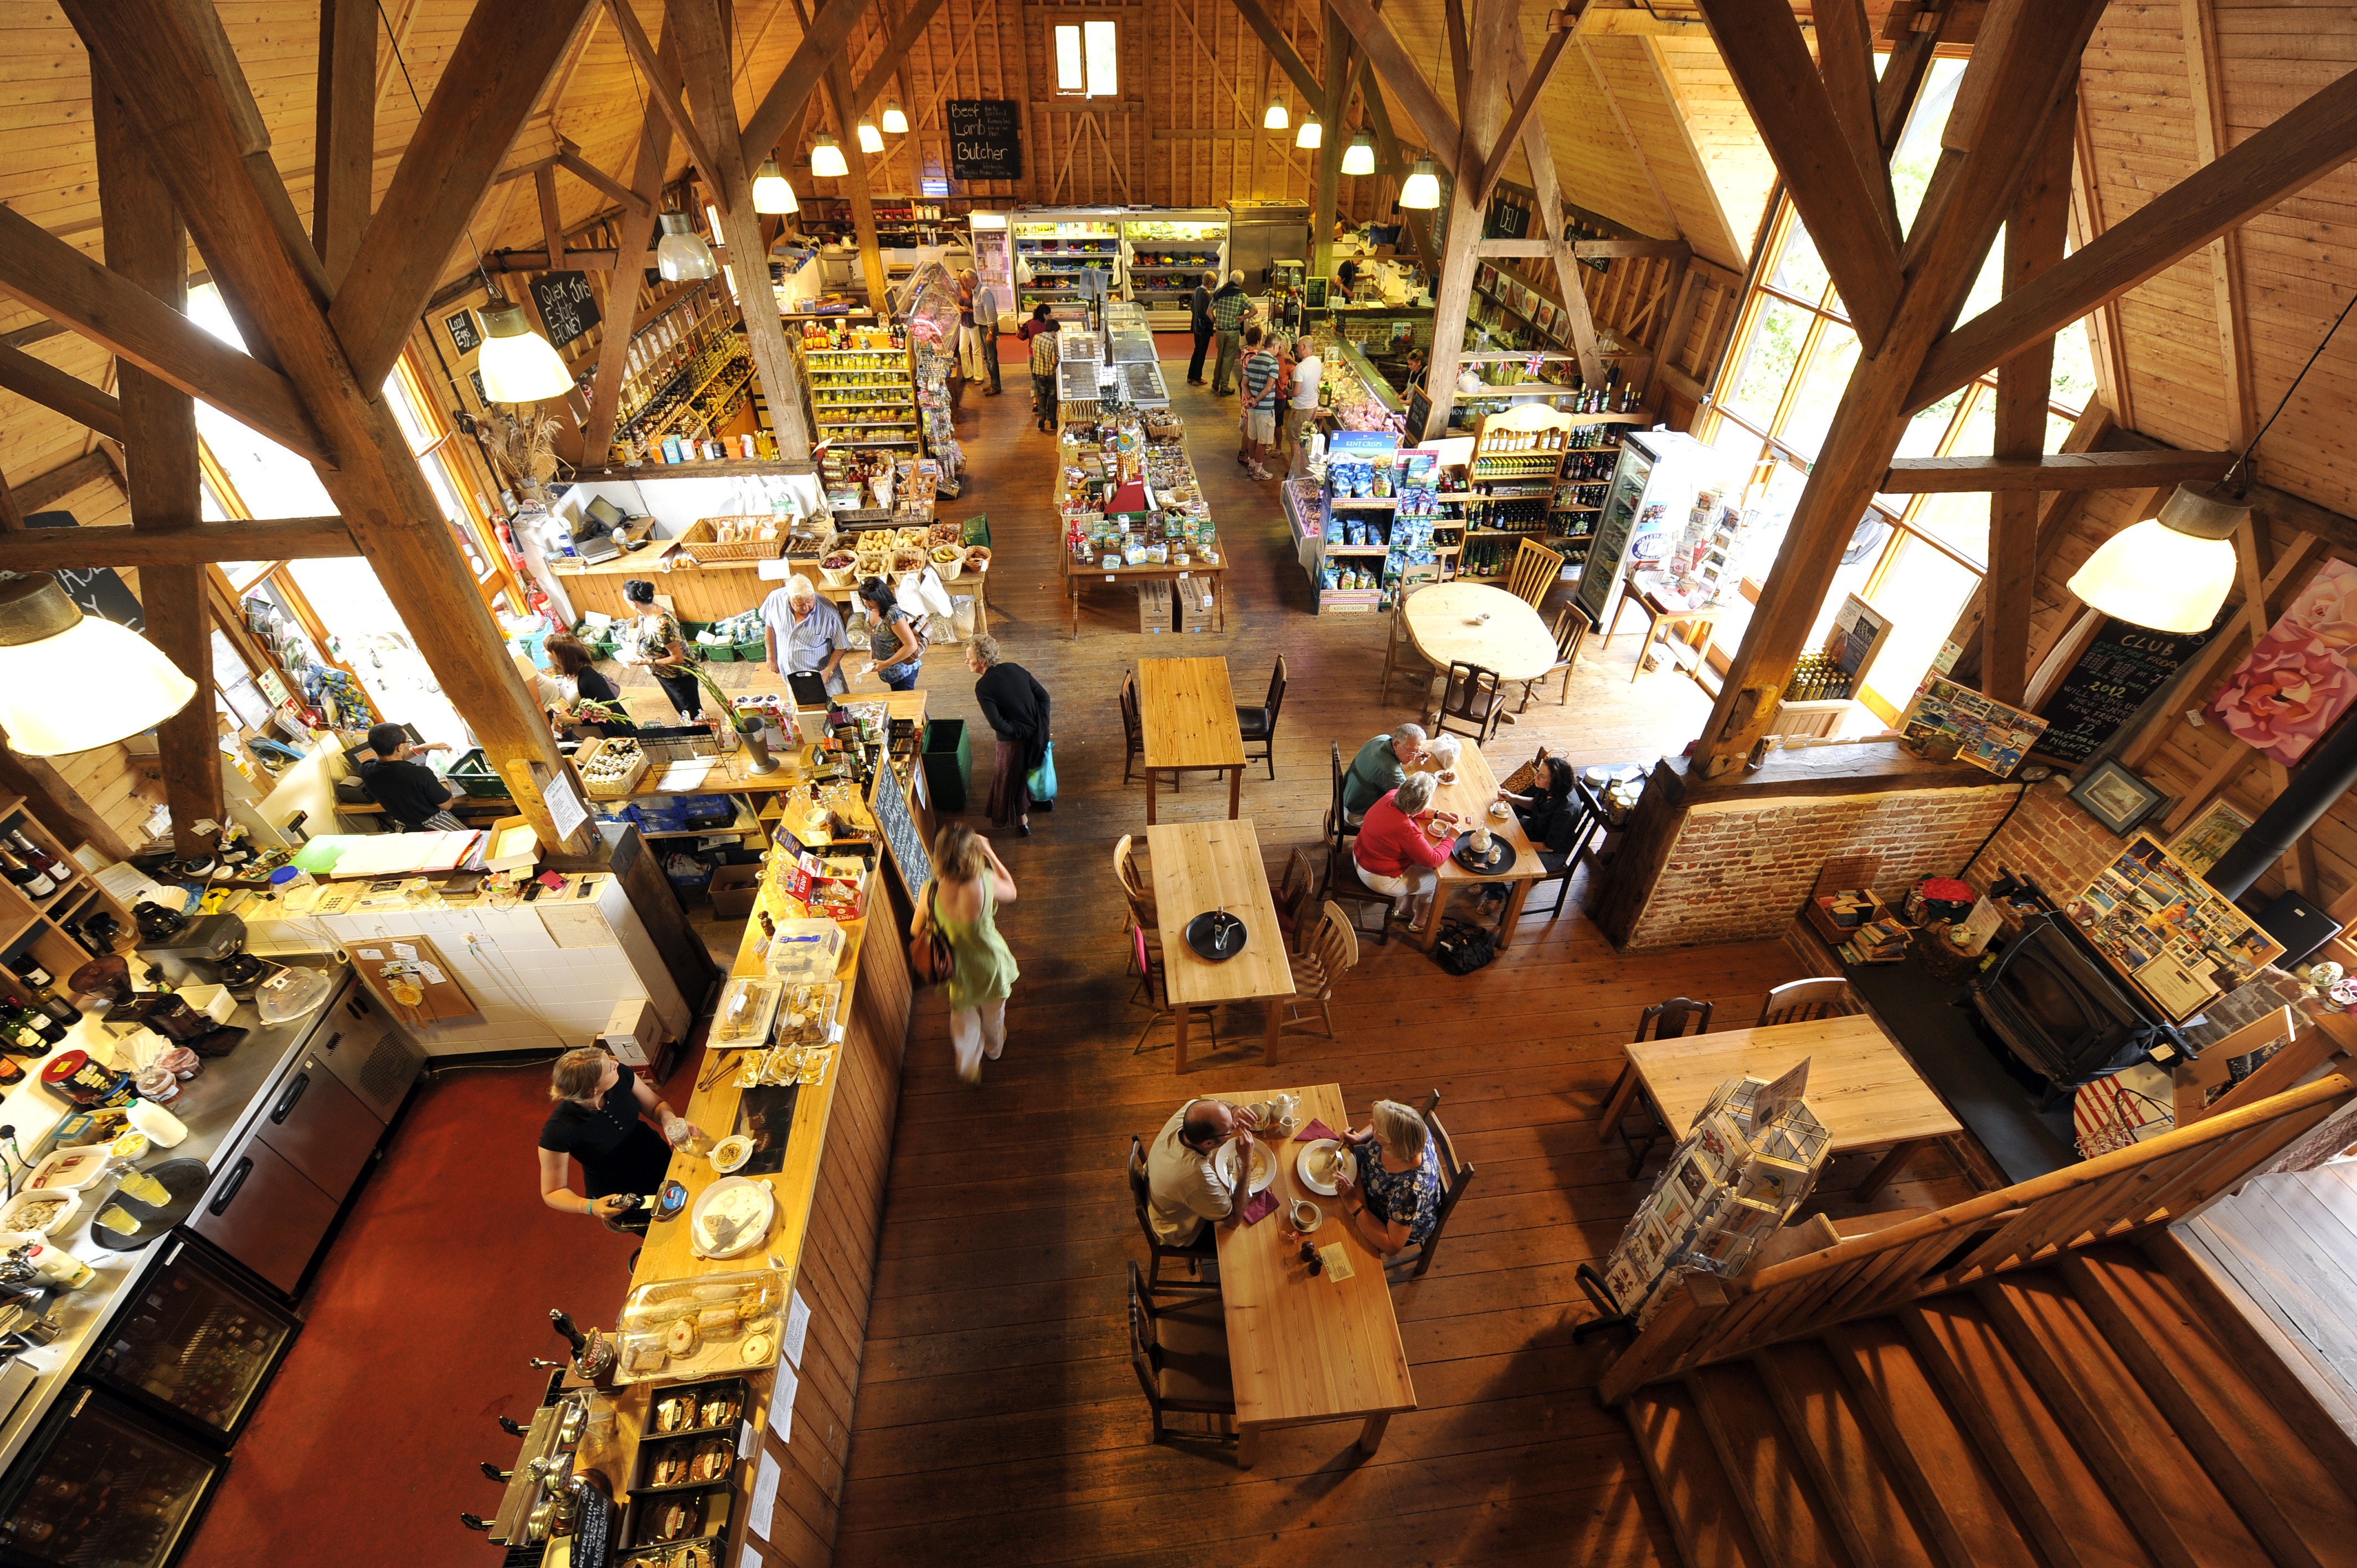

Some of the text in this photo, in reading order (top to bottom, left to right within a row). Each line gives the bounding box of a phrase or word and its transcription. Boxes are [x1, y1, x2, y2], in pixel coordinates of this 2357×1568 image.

[951, 103, 980, 118] Beef
[954, 118, 985, 136] Lamb
[958, 141, 1008, 160] Butcher
[1499, 205, 1519, 235] DELI
[541, 281, 568, 308] Quex
[448, 313, 466, 332] Local
[545, 299, 577, 329] Estate
[454, 328, 471, 348] Eggs
[553, 313, 583, 346] HONEY
[2095, 641, 2123, 654] EVERY
[2123, 648, 2147, 659] FIRST
[2121, 635, 2176, 656] CLUB
[2104, 650, 2128, 662] THE
[2128, 657, 2164, 673] MONTH
[2137, 670, 2149, 679] AT
[2063, 685, 2090, 698] WILL
[2092, 692, 2123, 708] BRING
[2126, 680, 2149, 694] PARTY
[2066, 703, 2091, 715] NEW
[2073, 697, 2098, 708] NEW
[2072, 721, 2096, 736] 12
[2082, 716, 2102, 726] AND
[2049, 736, 2092, 754] NIGHTS
[2054, 749, 2074, 757] JOIN
[877, 766, 891, 811] LADIES
[884, 776, 896, 818] NIGHT
[798, 874, 807, 893] TEDDY
[579, 1491, 595, 1568] REFRESHING
